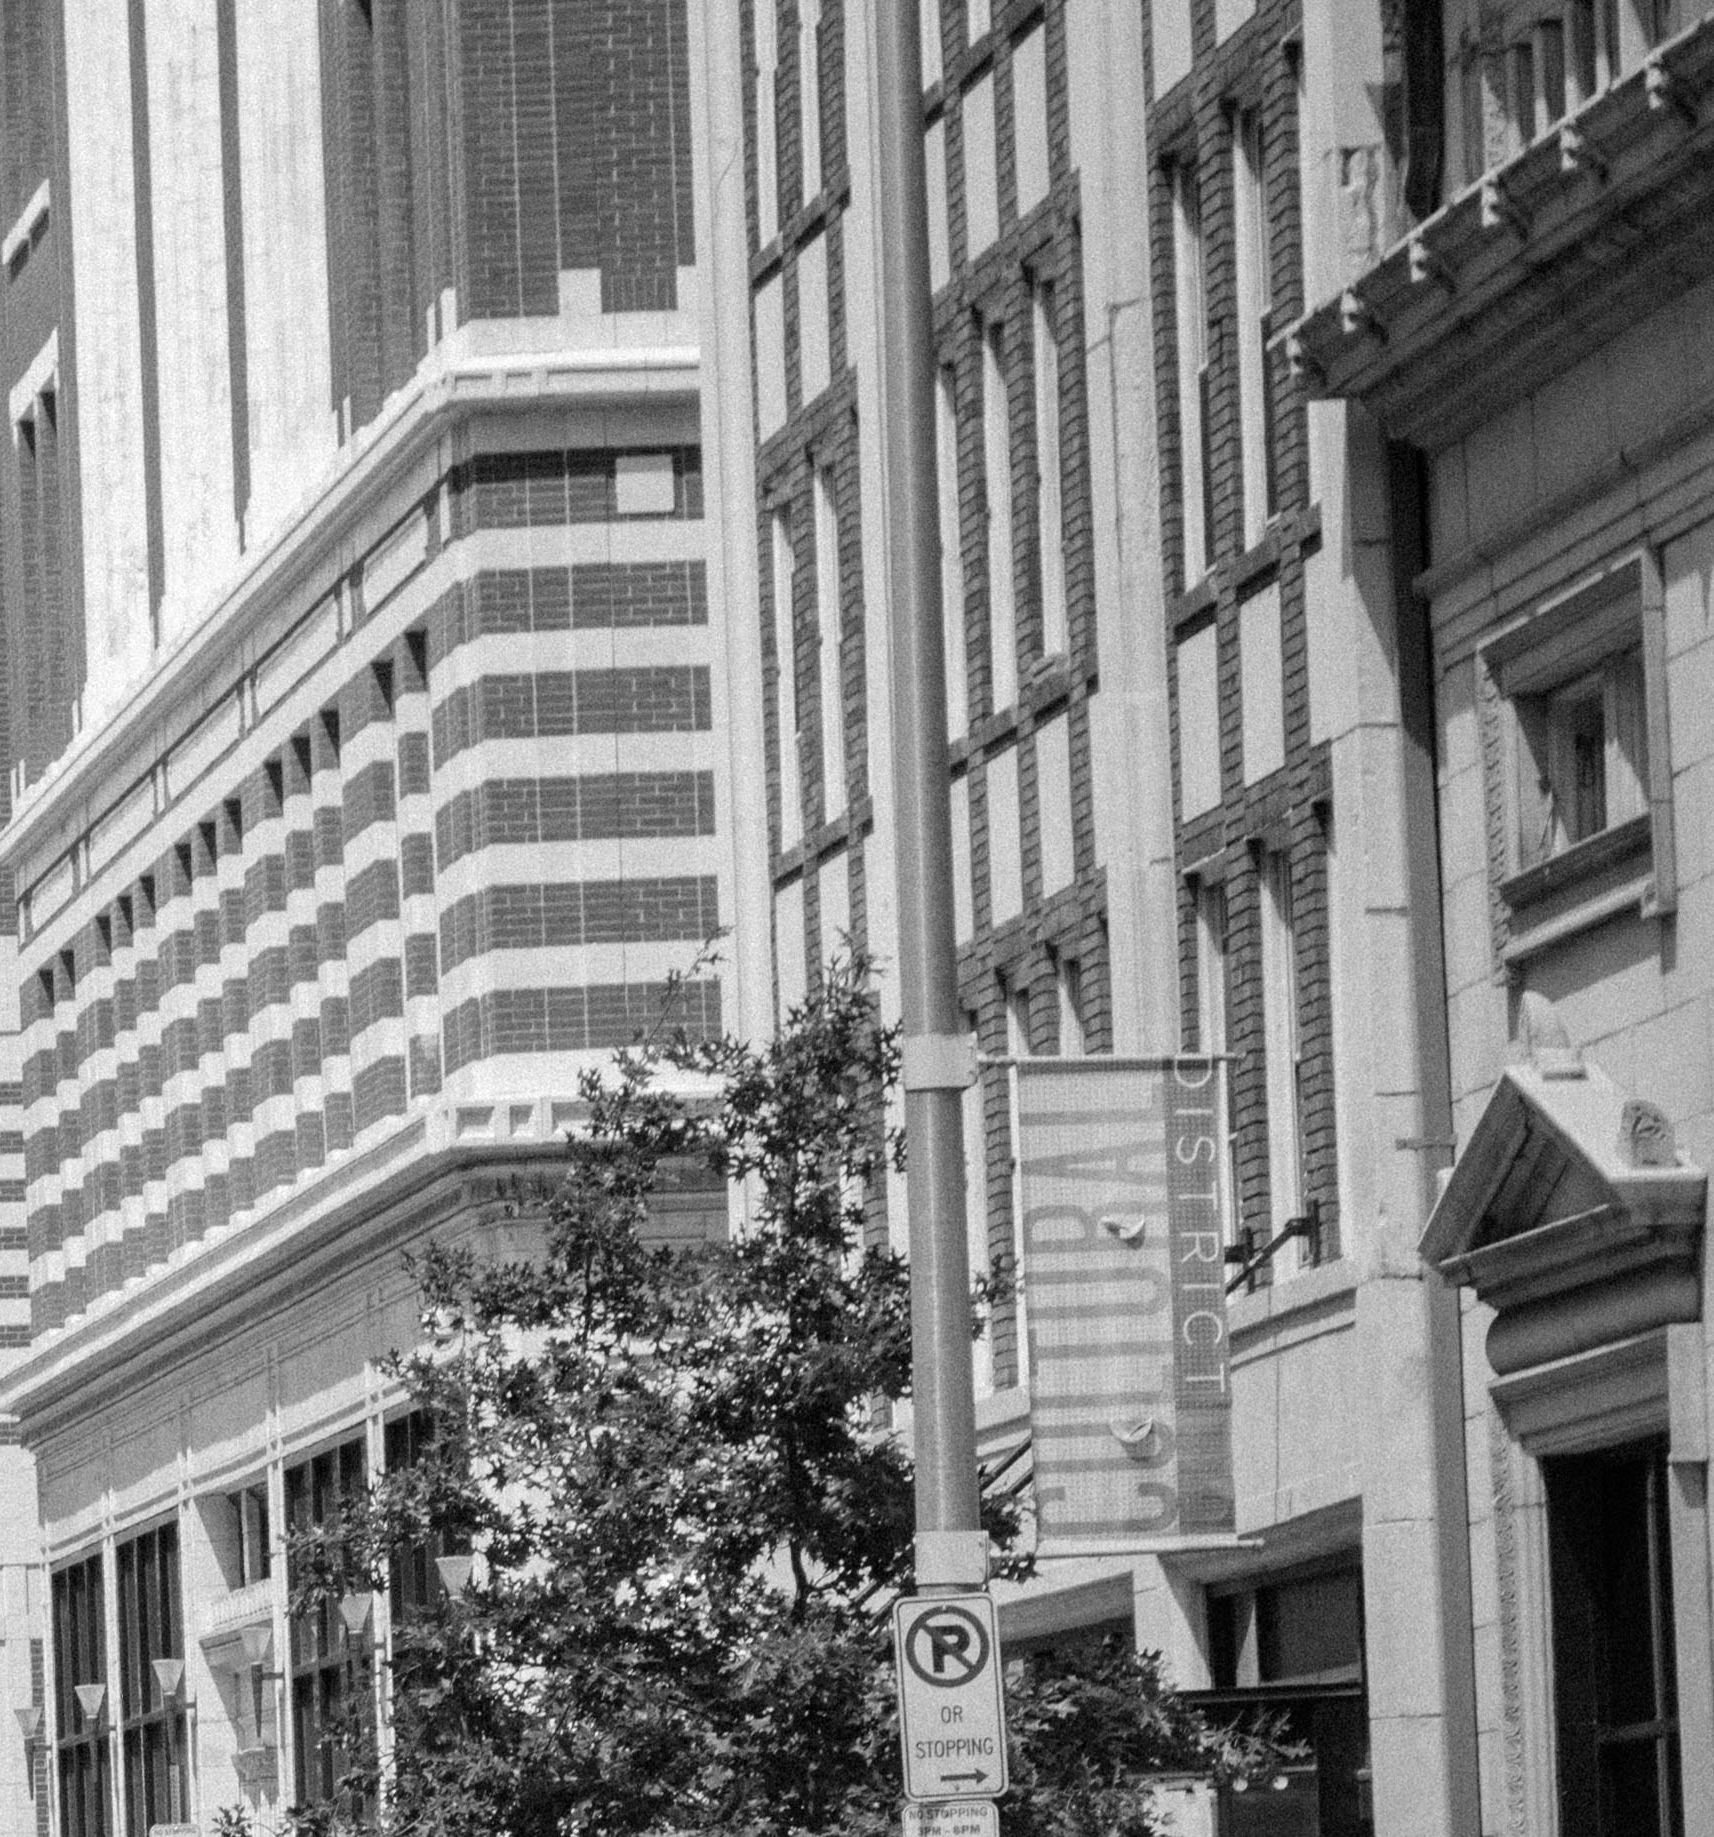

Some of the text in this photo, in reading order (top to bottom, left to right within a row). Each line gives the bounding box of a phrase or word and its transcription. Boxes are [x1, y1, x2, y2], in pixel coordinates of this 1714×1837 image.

[1174, 1054, 1226, 1393] DISTRICT
[940, 1705, 964, 1724] OR
[915, 1737, 994, 1760] STOPPING
[908, 1806, 988, 1820] NO STOPPING
